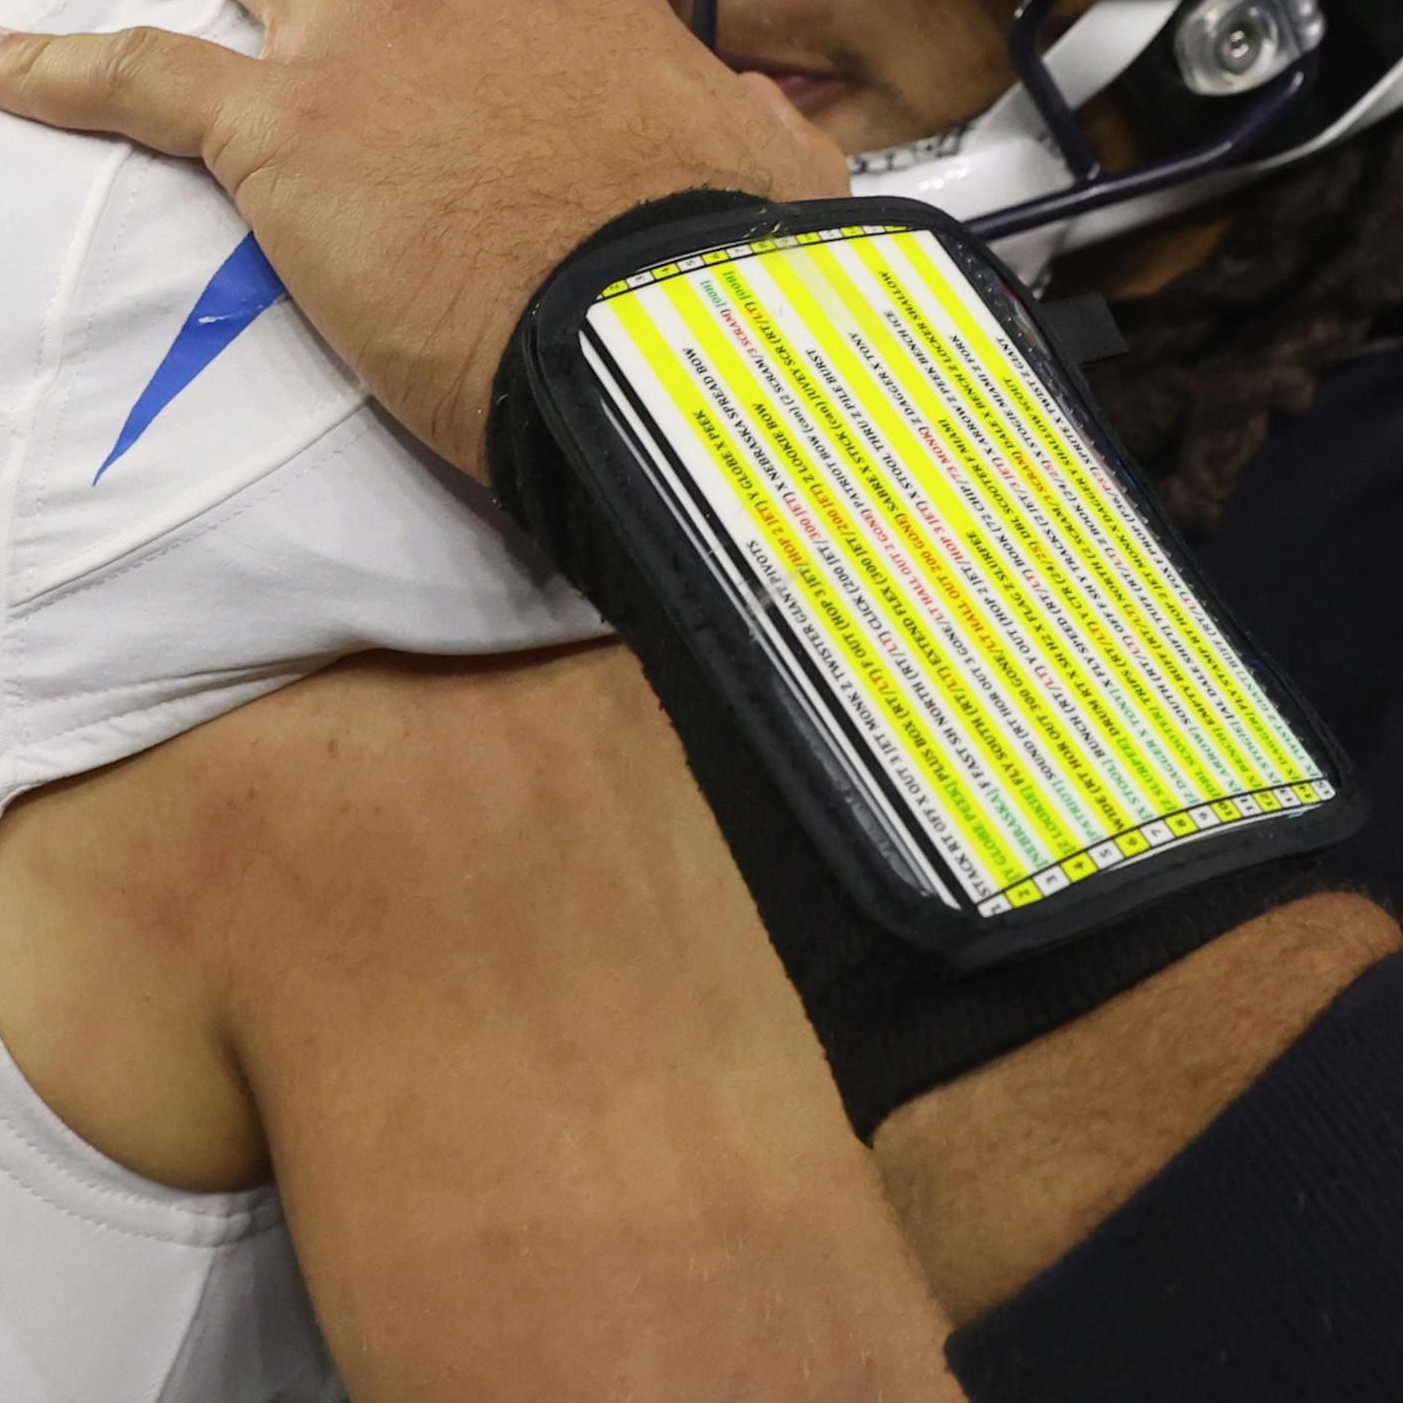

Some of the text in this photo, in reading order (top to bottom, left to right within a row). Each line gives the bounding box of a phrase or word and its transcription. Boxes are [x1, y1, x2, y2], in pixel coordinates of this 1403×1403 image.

[745, 539, 782, 585] PIVOTS
[801, 623, 844, 681] TWISTER
[847, 691, 876, 731] MONK
[872, 732, 897, 755] JET
[894, 767, 921, 795] OUT
[921, 807, 946, 833] OFF
[939, 833, 960, 854] RT
[954, 852, 997, 898] STACK
